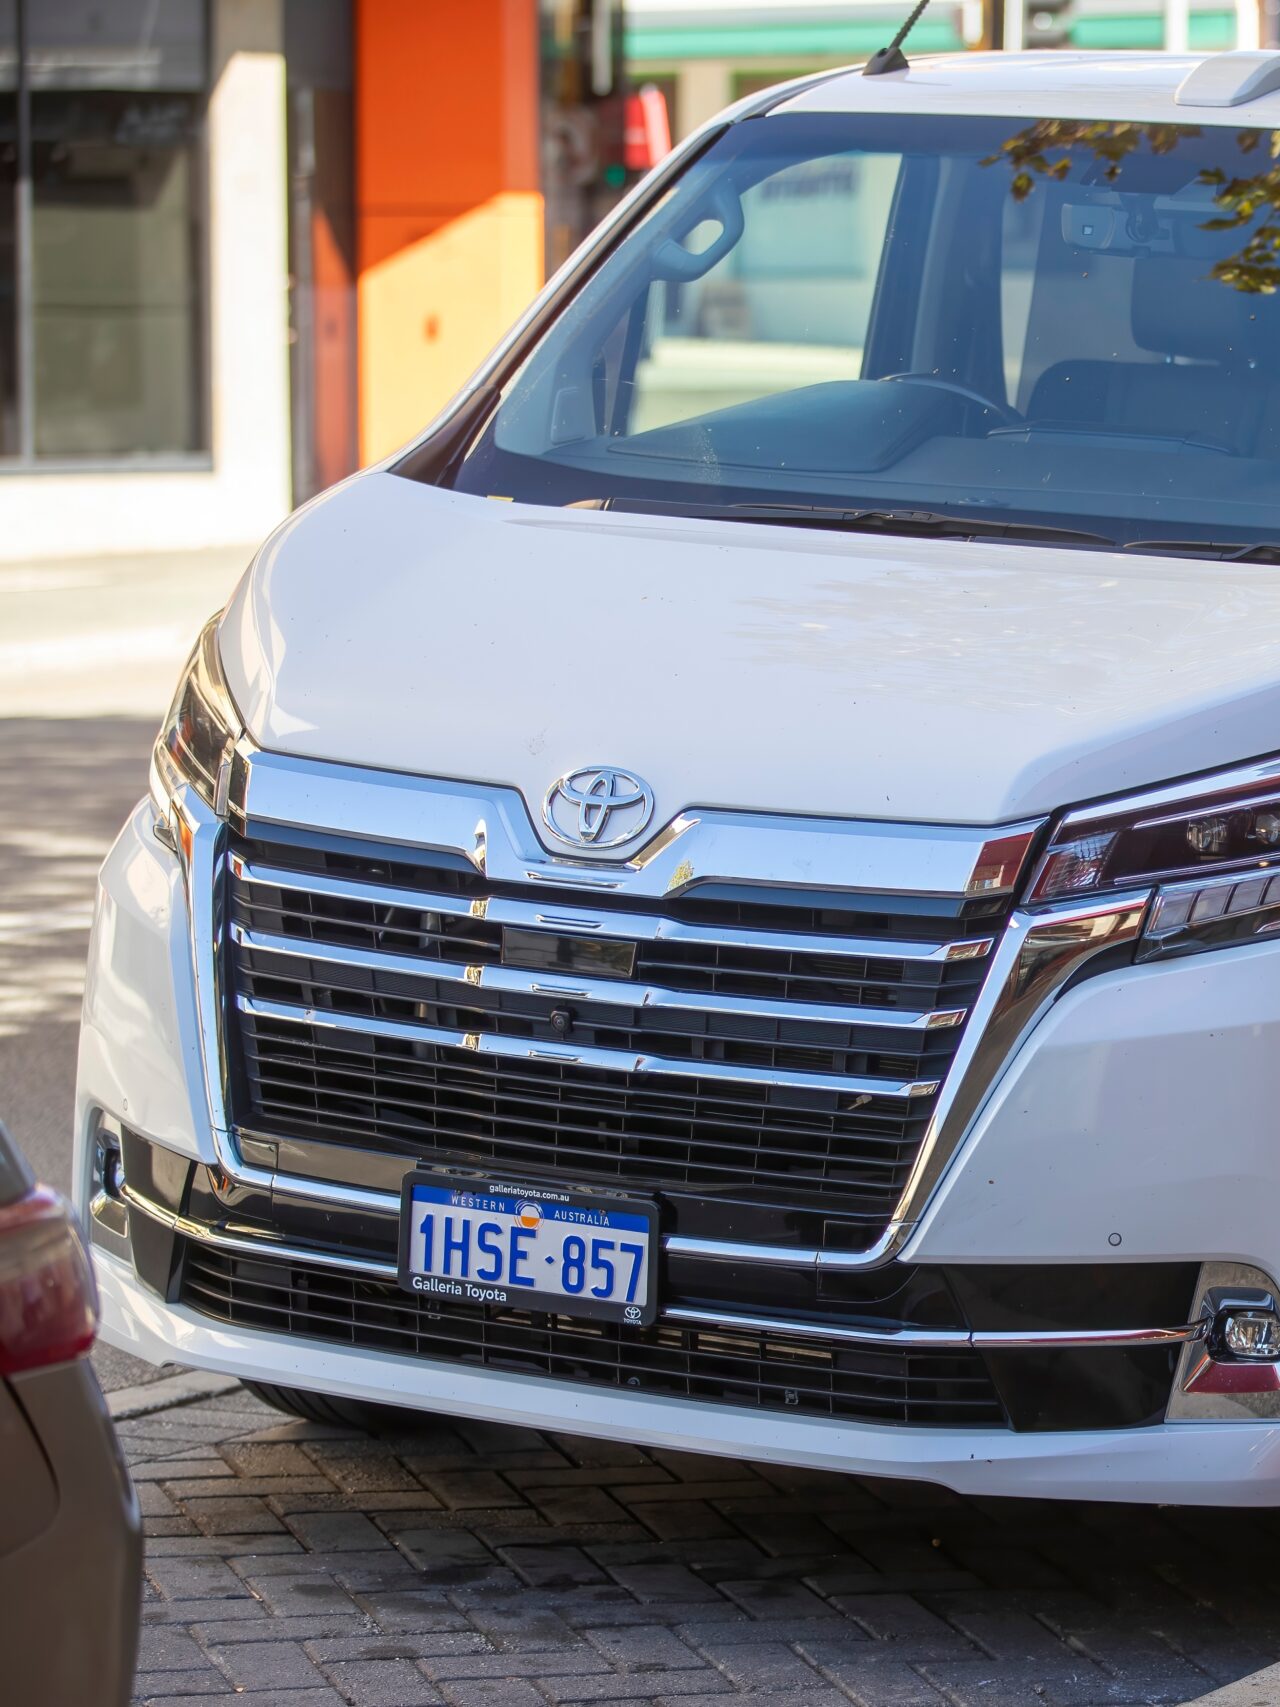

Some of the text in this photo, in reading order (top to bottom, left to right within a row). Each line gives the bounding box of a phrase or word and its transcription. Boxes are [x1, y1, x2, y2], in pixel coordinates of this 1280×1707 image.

[489, 1184, 570, 1202] galleriatoyota.com.au
[451, 1195, 610, 1226] WESTERN AUSTRALIA
[412, 1276, 507, 1302] Galleria Toyota
[623, 1317, 642, 1326] TOYOTA
